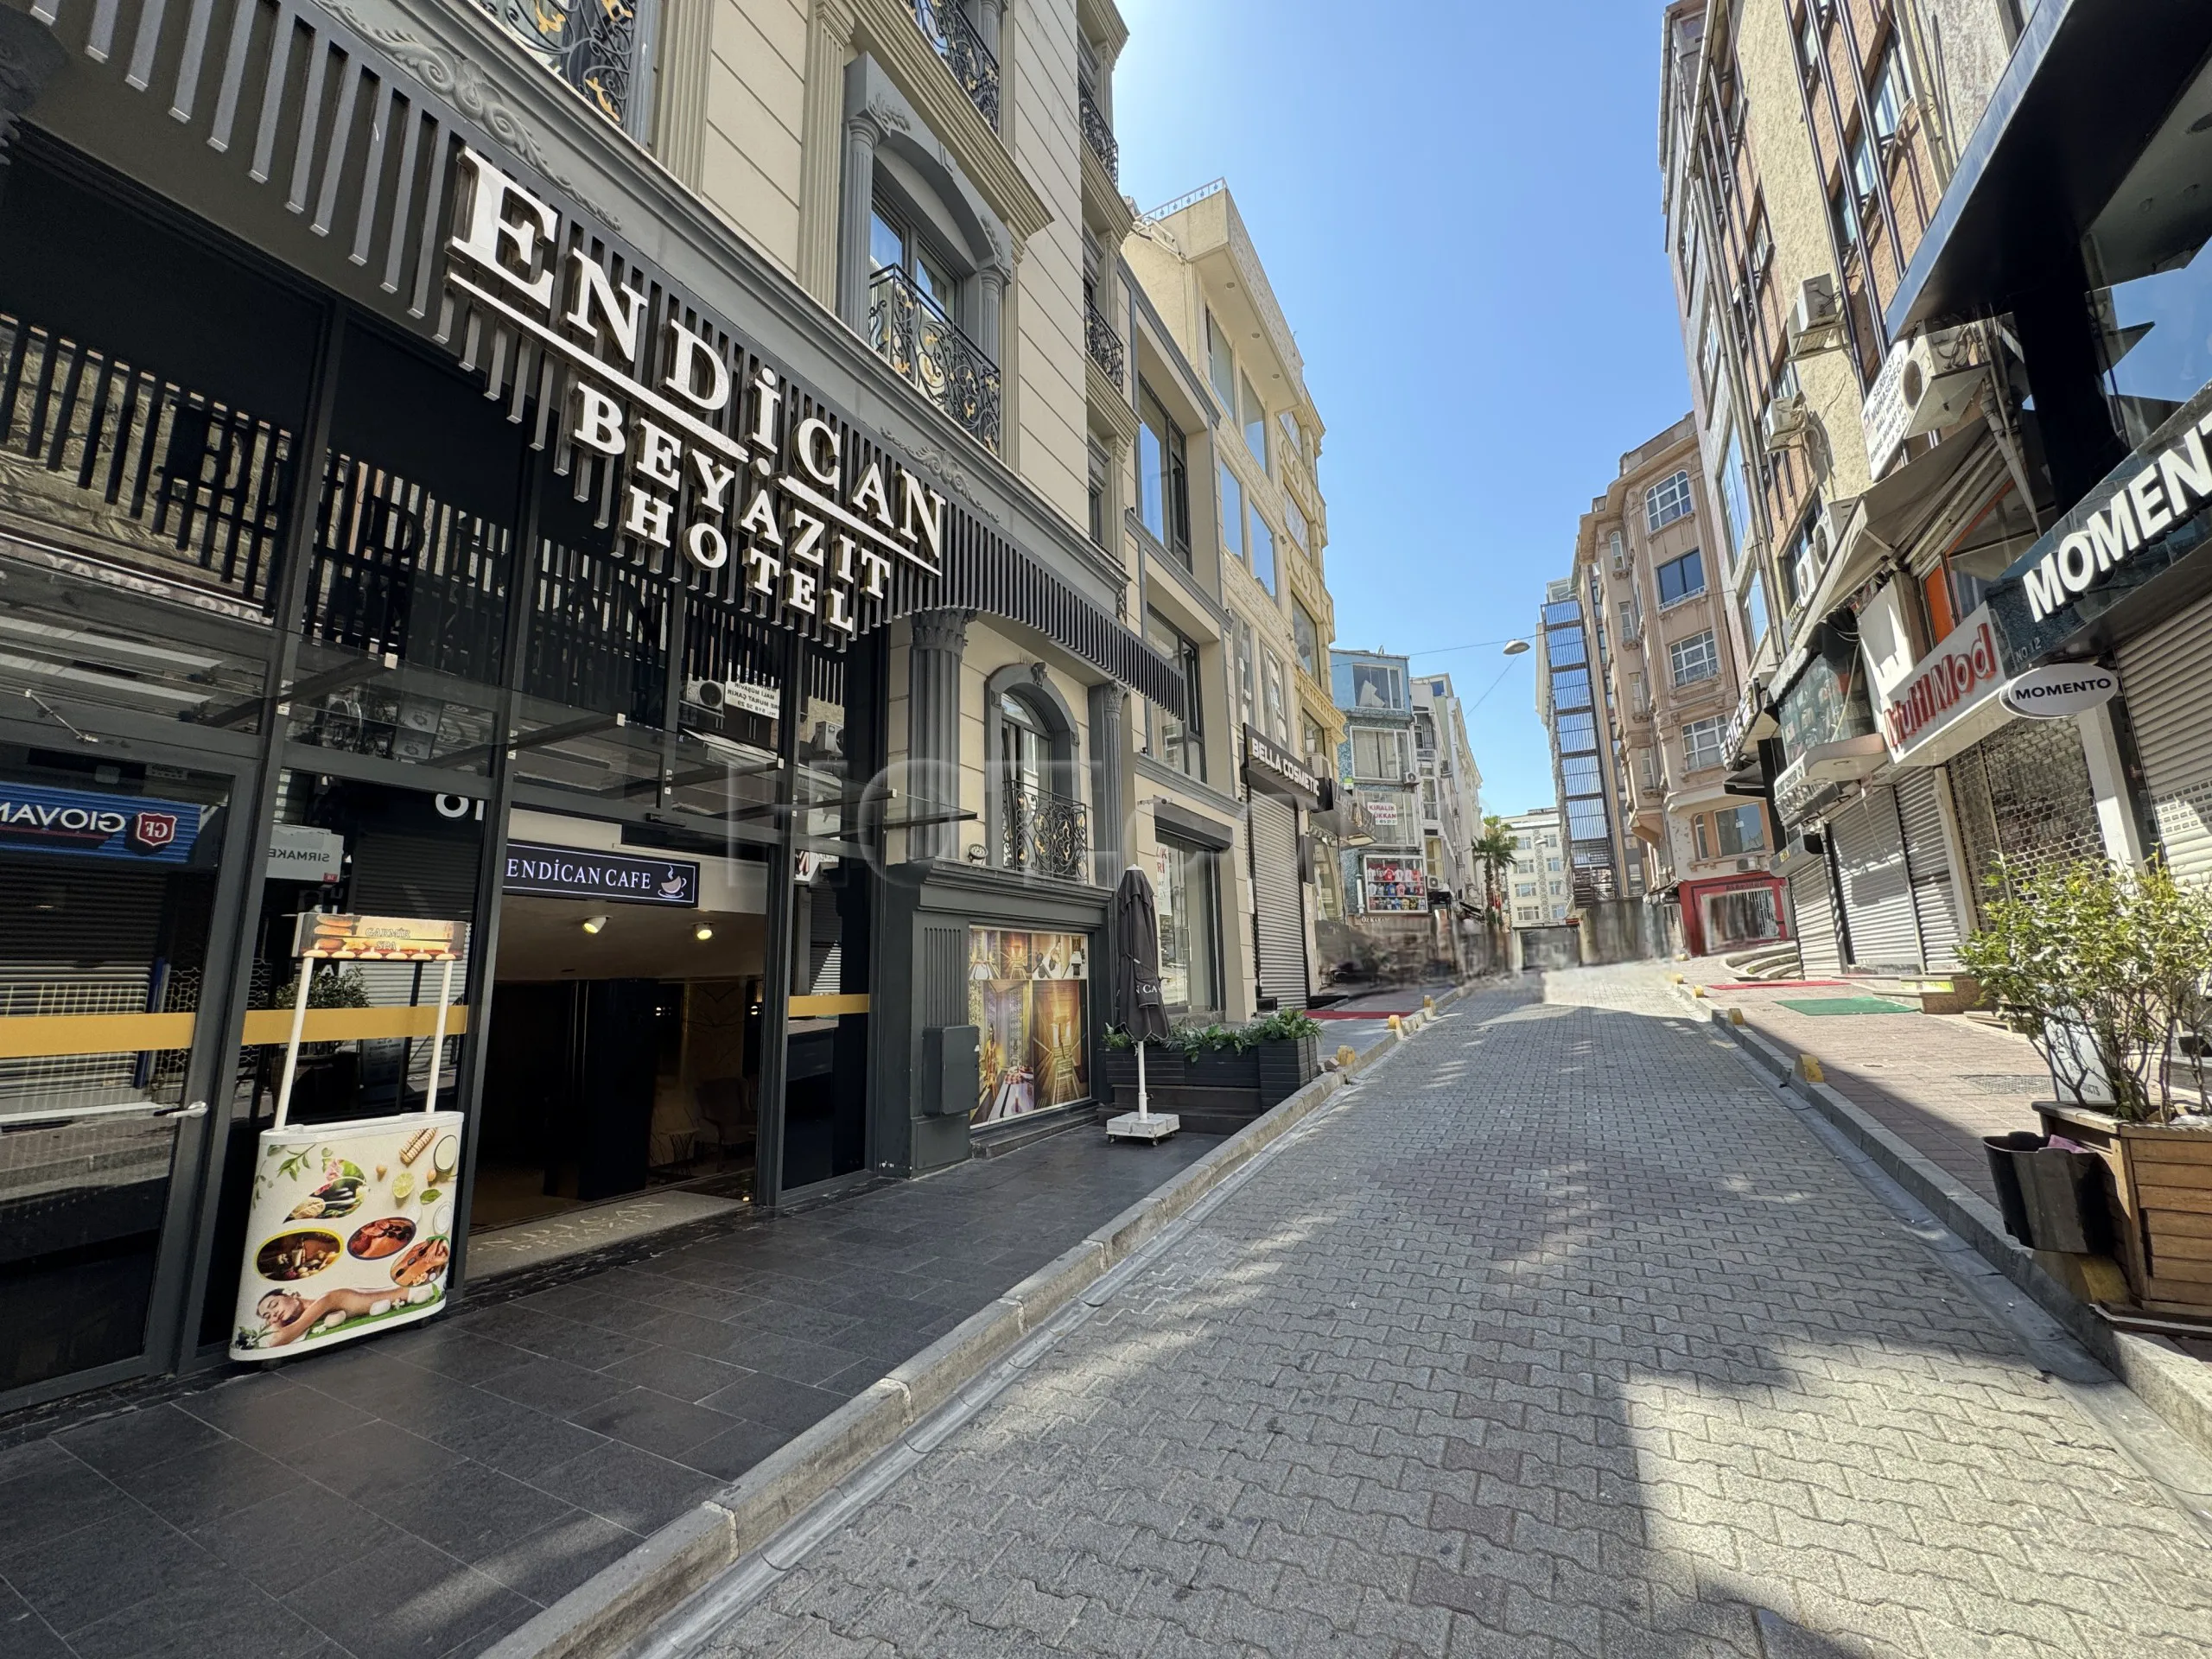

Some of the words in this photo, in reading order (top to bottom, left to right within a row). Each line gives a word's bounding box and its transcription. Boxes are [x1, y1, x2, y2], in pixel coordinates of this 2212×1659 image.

[573, 381, 891, 600] BEYAZIT
[2022, 410, 2212, 623] MOMEN
[626, 485, 854, 634] HOTEL
[2015, 646, 2028, 663] NO
[2031, 637, 2042, 653] 12
[2015, 678, 2112, 701] MOMENTO
[1252, 738, 1282, 774] BELLA
[1282, 758, 1320, 798] COSMETIC
[506, 859, 601, 885] ENDİCAN
[606, 868, 651, 889] CAFE
[377, 941, 397, 950] SPA
